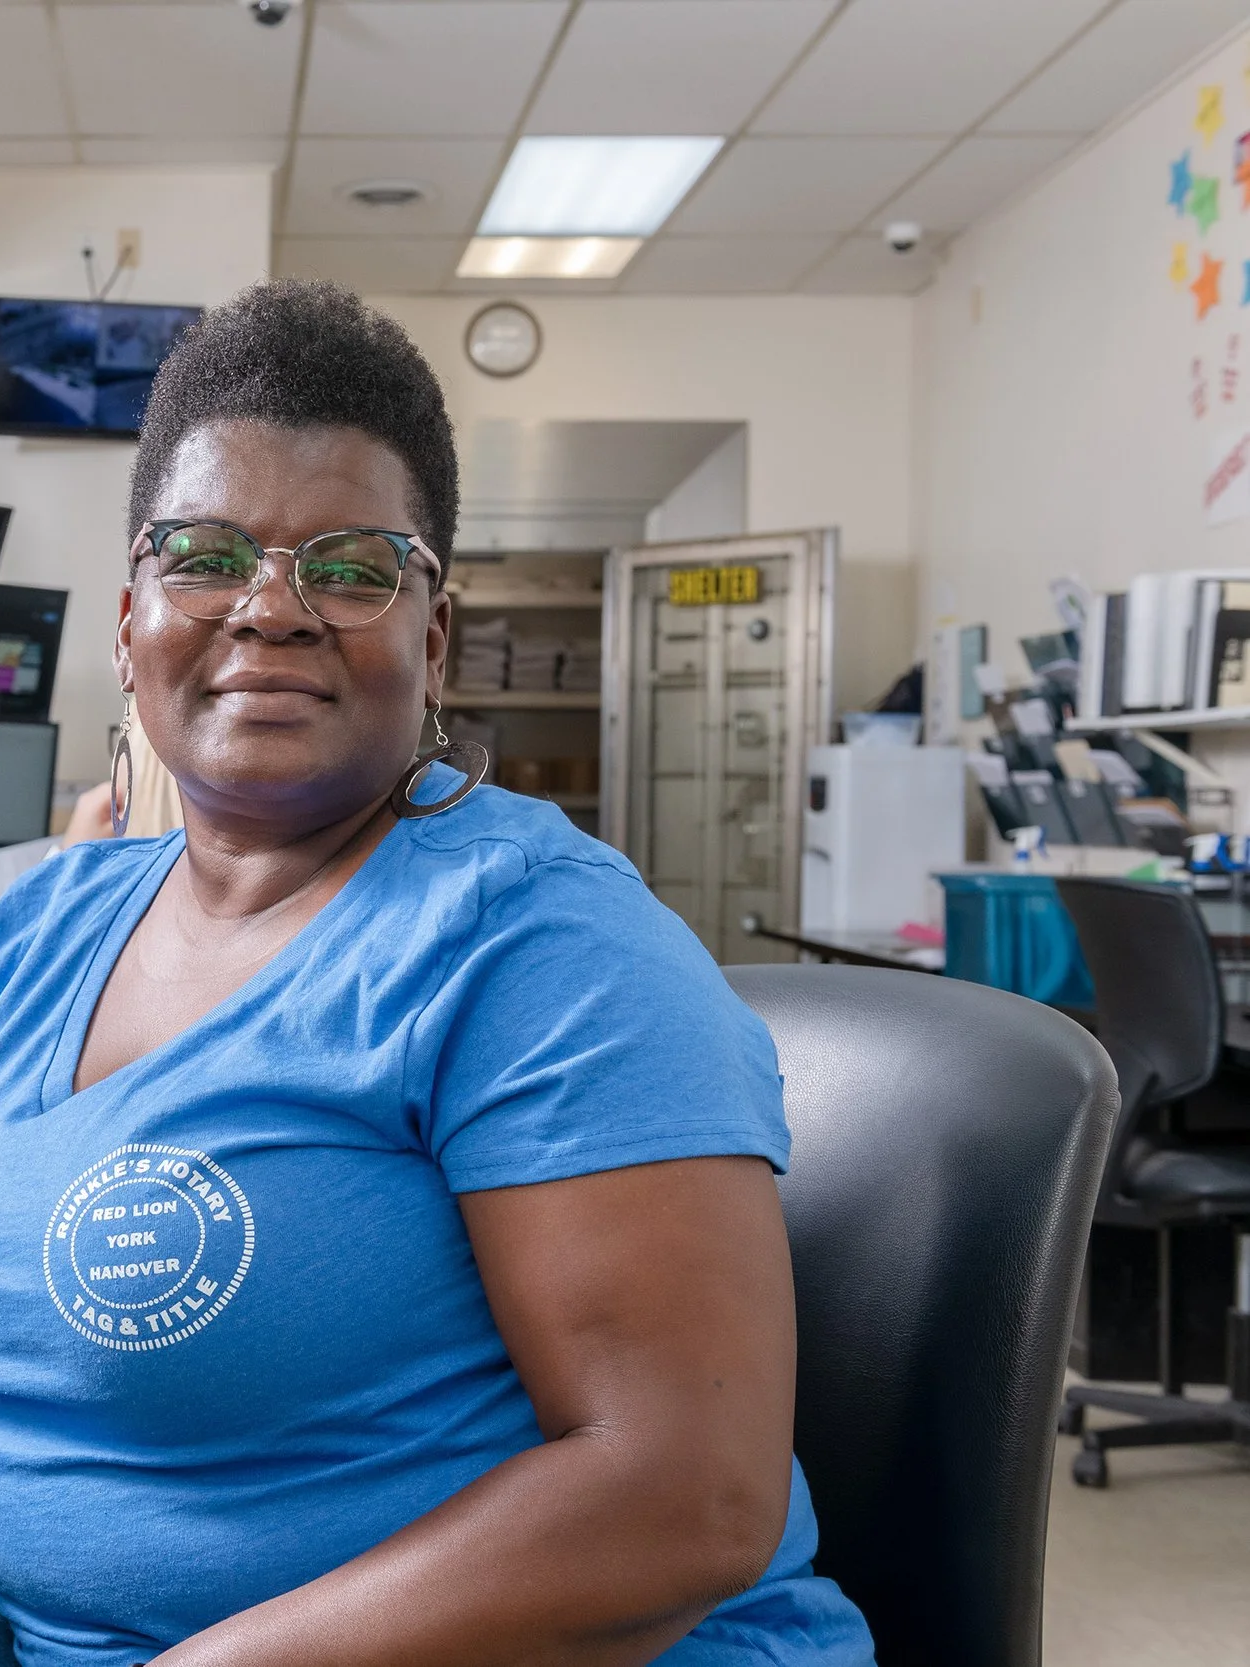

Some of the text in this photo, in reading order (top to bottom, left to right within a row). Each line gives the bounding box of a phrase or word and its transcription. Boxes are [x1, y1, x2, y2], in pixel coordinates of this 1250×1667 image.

[56, 1158, 232, 1239] RUNKLE'S NOTARY
[92, 1200, 177, 1222] RED LION
[106, 1231, 156, 1249] YORK
[90, 1258, 180, 1281] HANOVER
[71, 1275, 219, 1335] TAG & TITLE
